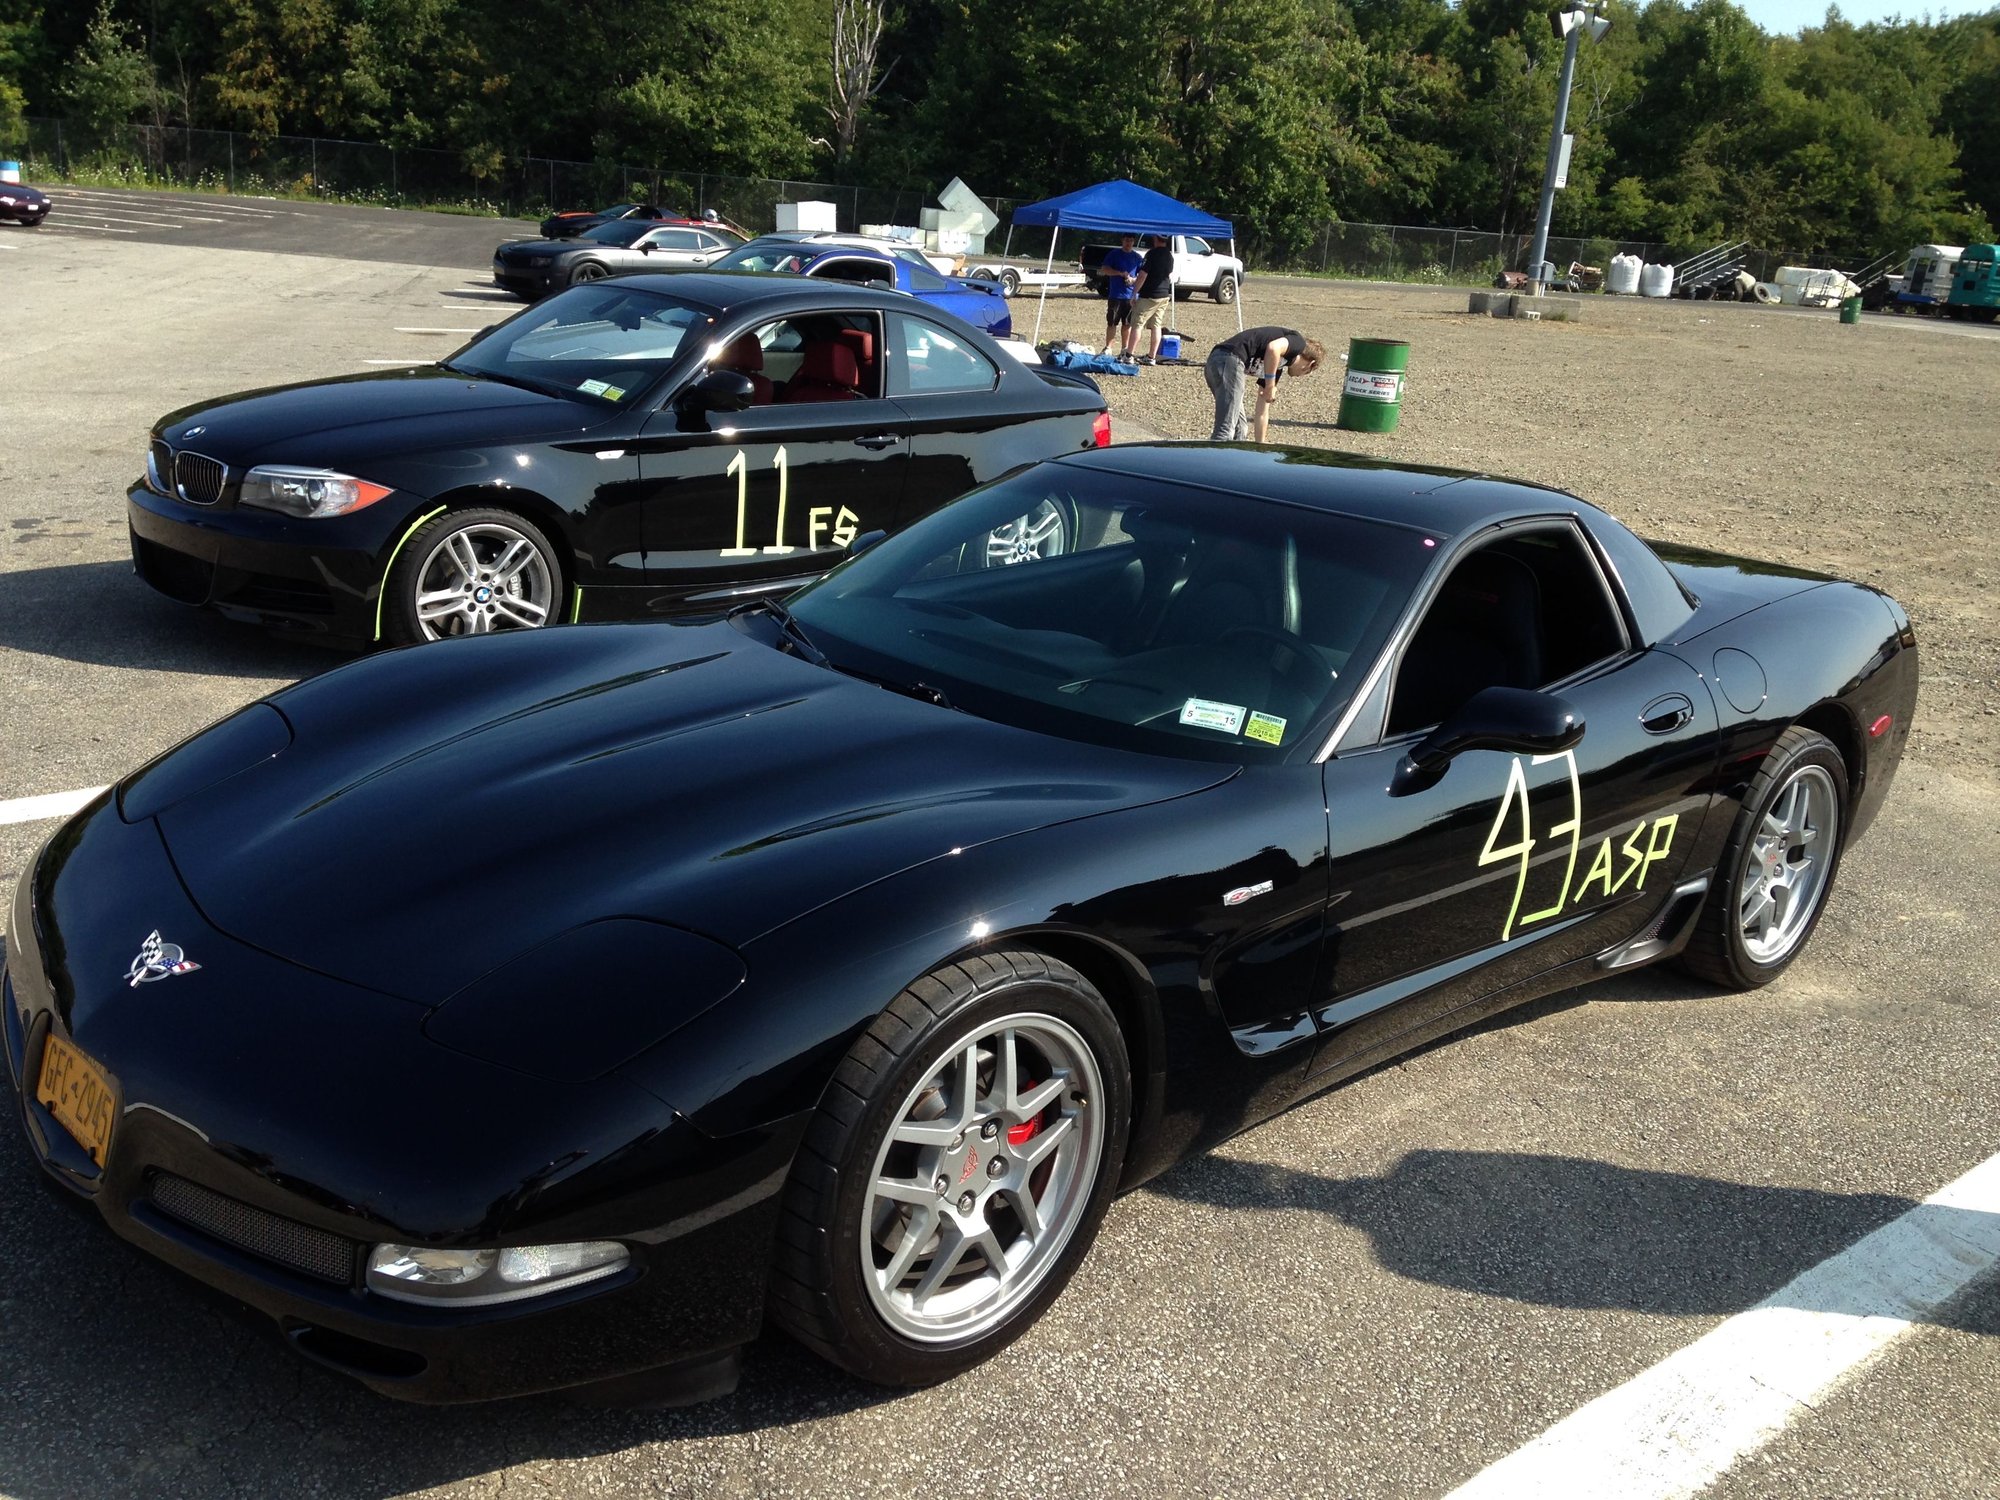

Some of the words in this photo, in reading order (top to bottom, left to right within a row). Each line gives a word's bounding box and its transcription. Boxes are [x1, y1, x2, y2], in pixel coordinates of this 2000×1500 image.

[720, 445, 795, 557] 11
[809, 505, 860, 552] FS
[1224, 717, 1236, 726] 15
[1574, 813, 1679, 903] ASP
